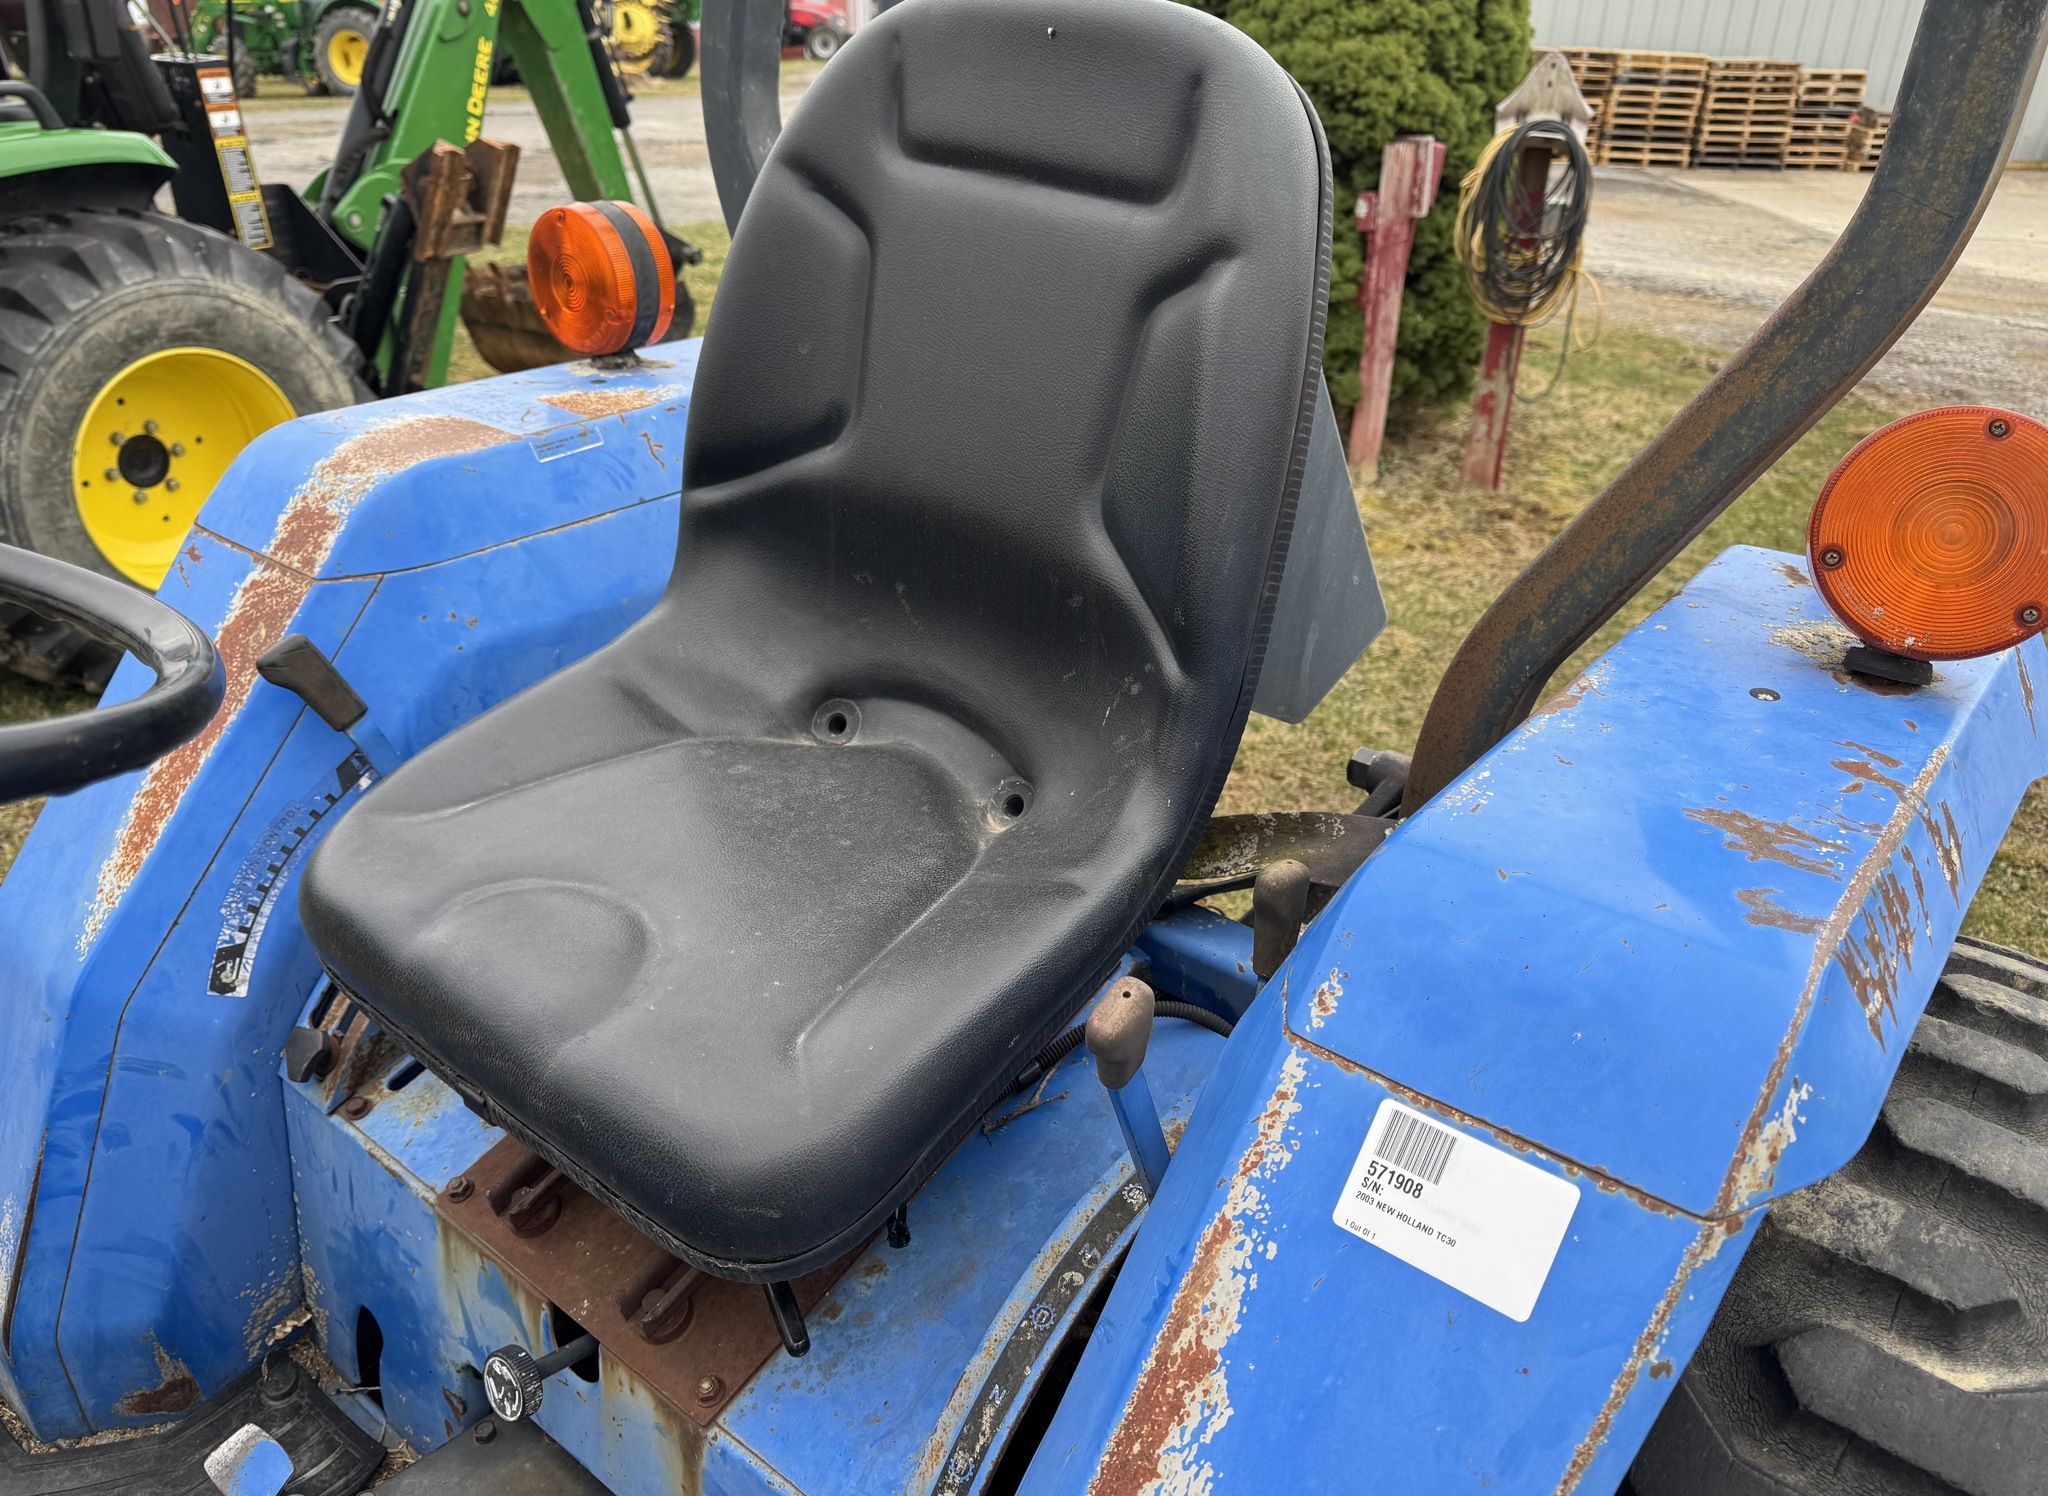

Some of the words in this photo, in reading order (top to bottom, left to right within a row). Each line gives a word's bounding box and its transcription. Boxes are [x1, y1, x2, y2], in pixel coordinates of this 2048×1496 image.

[466, 36, 493, 117] DEERE
[258, 804, 302, 857] CONTROL
[1361, 1176, 1384, 1196] S/N:
[1367, 1160, 1424, 1199] 571908
[1344, 1218, 1349, 1226] 1
[1372, 1232, 1376, 1240] 1
[1355, 1190, 1375, 1206] 2003
[1376, 1200, 1396, 1216] NEW
[1396, 1211, 1434, 1236] HOLLAND
[1436, 1231, 1457, 1247] TC30
